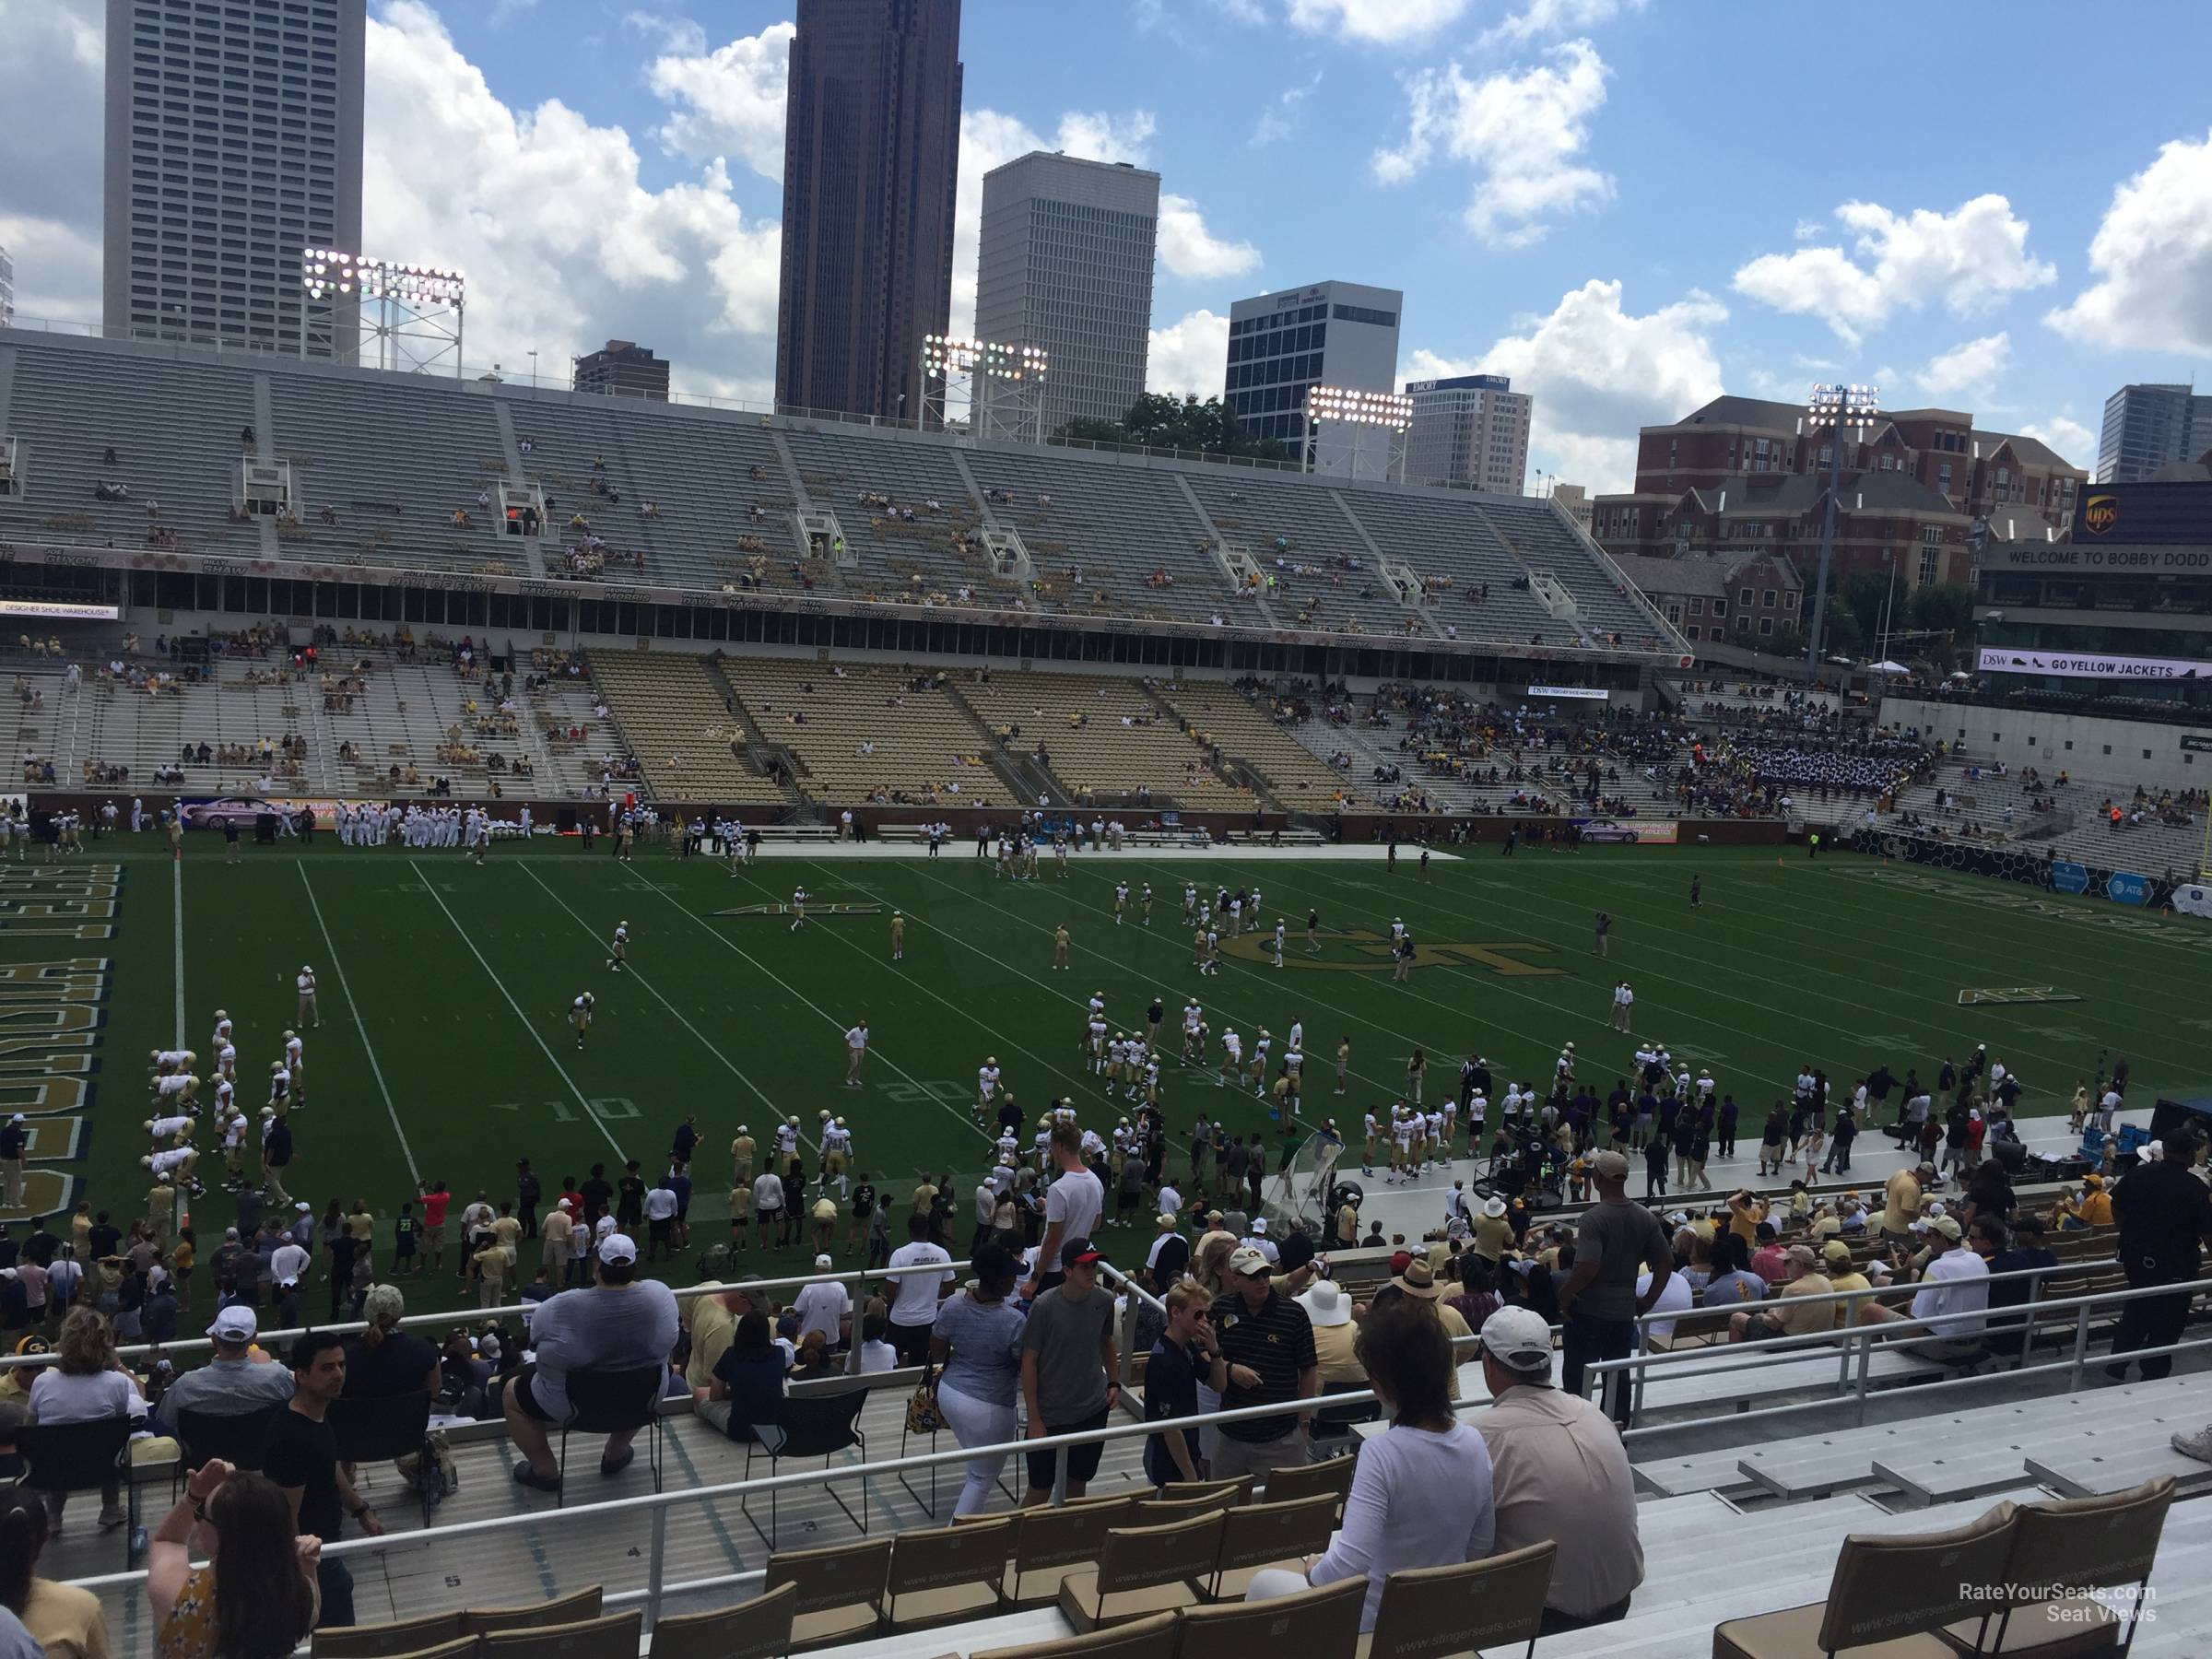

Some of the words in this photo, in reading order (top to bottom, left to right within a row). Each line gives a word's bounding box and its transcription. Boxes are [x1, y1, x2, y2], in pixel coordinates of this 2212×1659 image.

[1486, 375, 1508, 384] EMORY
[1412, 380, 1438, 392] EMORY
[2088, 507, 2116, 529] ups
[44, 555, 98, 566] GUYON
[2009, 551, 2079, 565] WELCOME
[2085, 552, 2104, 565] TO
[2108, 553, 2159, 566] BOBBY
[2164, 553, 2210, 567] DODD
[203, 565, 247, 575] SHAW
[442, 573, 484, 582] FOOTBALL
[389, 576, 427, 589] HALL
[431, 580, 453, 590] OF
[454, 582, 498, 592] FAME
[519, 588, 581, 598] BAUGHAN
[605, 593, 650, 602] MORRIS
[682, 598, 716, 606] DAVIS
[729, 602, 784, 612] HAMILTON
[6, 604, 39, 613] DESIGNER
[41, 606, 60, 614] SHOE
[851, 609, 900, 619] FLOWERS
[1983, 653, 2007, 665] DSW
[2052, 659, 2067, 670] GO
[2070, 661, 2116, 674] YELLOW
[2118, 663, 2173, 677] JACKETS
[2125, 884, 2145, 897] AT&
[874, 1080, 976, 1102] 20
[543, 1097, 644, 1123] 10
[1394, 1616, 1534, 1655] www.stingerseats.com
